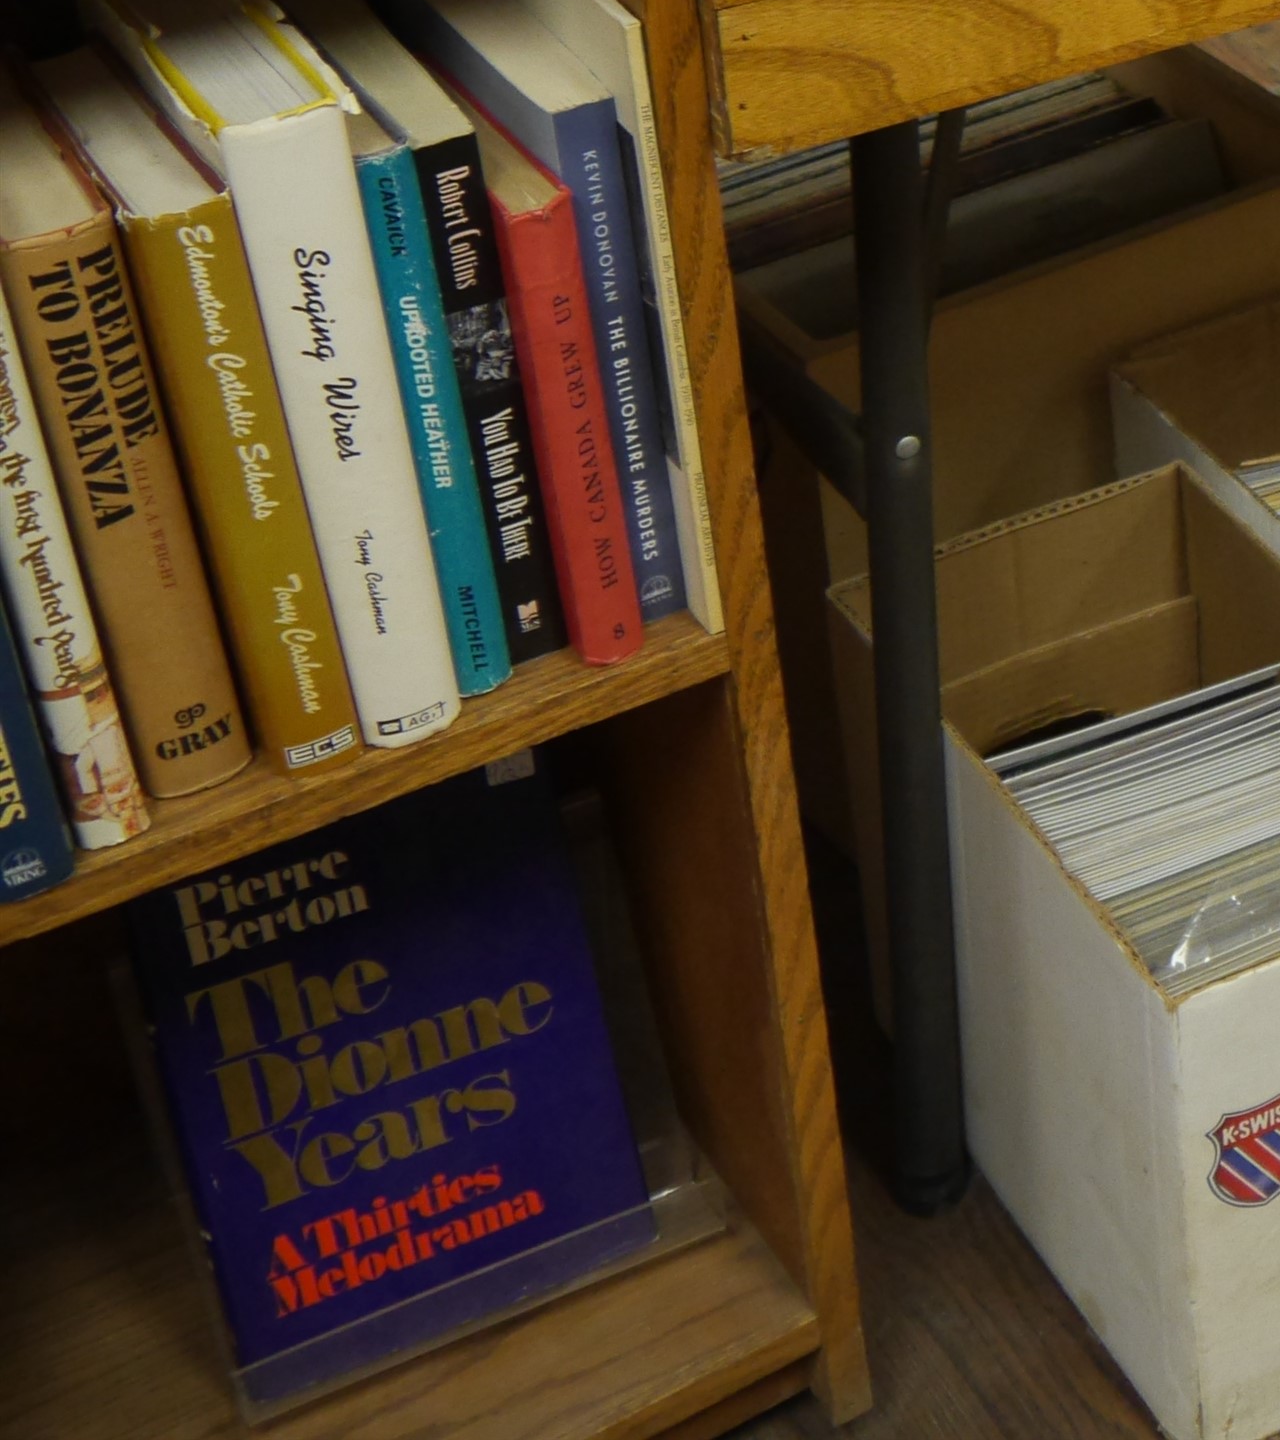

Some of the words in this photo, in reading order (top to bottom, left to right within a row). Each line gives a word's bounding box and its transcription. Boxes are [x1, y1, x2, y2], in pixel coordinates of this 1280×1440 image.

[641, 104, 651, 125] THE
[583, 149, 604, 206] KEVIN
[643, 125, 663, 191] MAGNIFICENT
[435, 164, 471, 230] Robert
[653, 192, 670, 244] DISTANCES
[28, 260, 81, 323] TO
[446, 228, 482, 292] Collins
[591, 210, 619, 304] DONOVAN
[77, 241, 160, 448] PRELUDE
[377, 176, 409, 258] CAVAICK
[398, 295, 434, 399] UPROOTED
[419, 402, 454, 490] HEATHER
[553, 294, 573, 326] UP
[606, 315, 629, 352] THE
[177, 224, 232, 347] Edmonton's
[208, 352, 256, 439] Catholic
[235, 442, 280, 522] Schools
[291, 246, 336, 362] Singing
[322, 376, 362, 463] Wires
[559, 341, 590, 410] GREW
[46, 329, 136, 531] BONANZA
[613, 357, 646, 472] BILLIONAIRE
[576, 419, 609, 524] CANADA
[14, 490, 44, 539] first
[354, 528, 375, 568] Tony
[631, 478, 659, 562] MURDERS
[701, 526, 714, 568] ARCHIVES
[19, 535, 74, 628] hundred
[149, 527, 178, 592] WRIGHT
[593, 537, 620, 589] HOW
[272, 572, 304, 626] Tony
[364, 571, 389, 637] Cashman
[457, 584, 490, 674] MITCHELL
[33, 628, 83, 689] years
[280, 627, 324, 715] Cashman
[155, 712, 233, 761] GRAY
[285, 725, 356, 768] ECS
[174, 849, 351, 930] Pierre
[181, 882, 371, 967] Berton
[184, 958, 392, 1063] The
[206, 980, 556, 1144] Dionne
[226, 1070, 518, 1213] Years
[267, 1232, 308, 1280] A
[302, 1164, 504, 1259] Thirties
[268, 1188, 546, 1319] Melodrama
